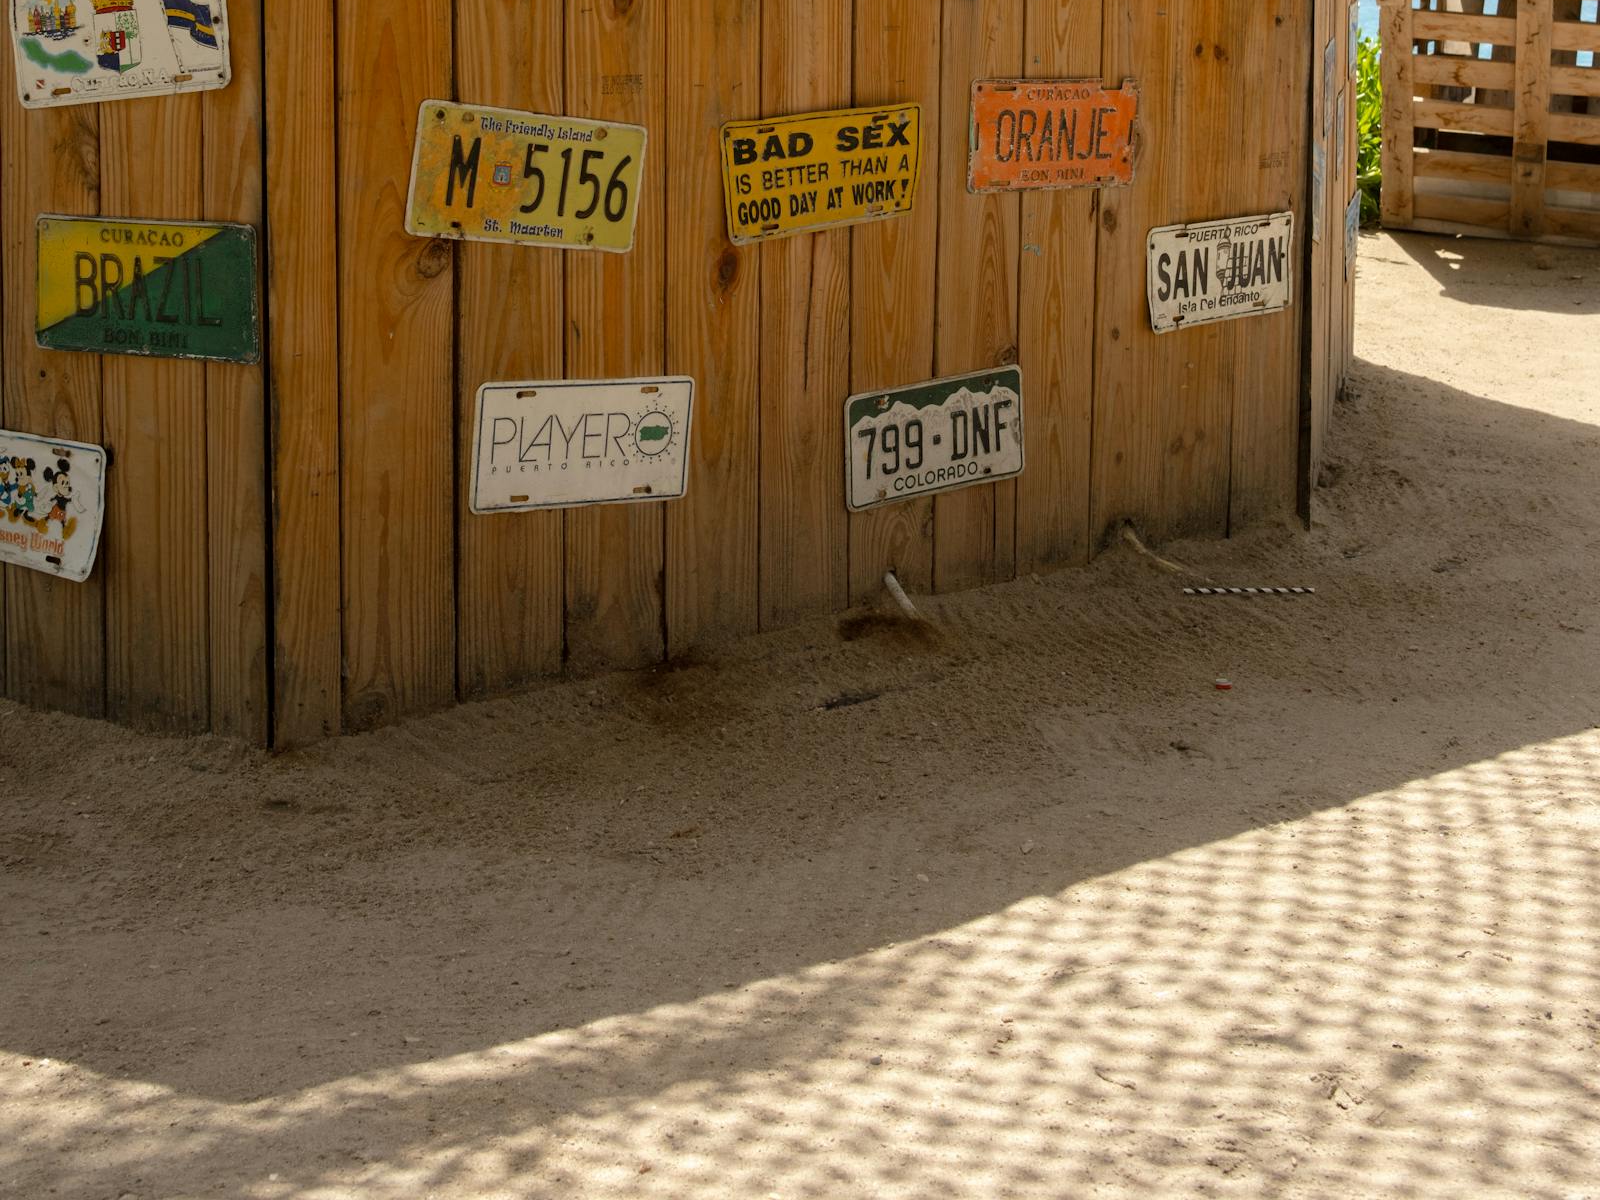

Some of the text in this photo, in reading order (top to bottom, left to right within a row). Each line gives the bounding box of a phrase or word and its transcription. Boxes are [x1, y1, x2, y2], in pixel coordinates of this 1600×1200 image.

[480, 117, 593, 142] The Friendly Island
[733, 120, 911, 165] BAD SEX
[995, 107, 1116, 163] ORANJE
[445, 134, 632, 222] M 5156
[735, 153, 909, 195] IS BETTER THAN A
[738, 197, 781, 226] GOOD
[790, 190, 818, 217] DAY
[827, 186, 844, 210] AT
[484, 219, 563, 238] St. Maarten
[1189, 224, 1259, 243] PUERTO RICO
[1157, 236, 1284, 302] SAN JUAN
[75, 251, 222, 327] BRAZIL
[1178, 300, 1197, 314] Isla
[103, 328, 142, 344] BON
[491, 459, 630, 474] PUERTO RICO
[893, 461, 978, 491] COLORADO
[31, 532, 65, 557] World
